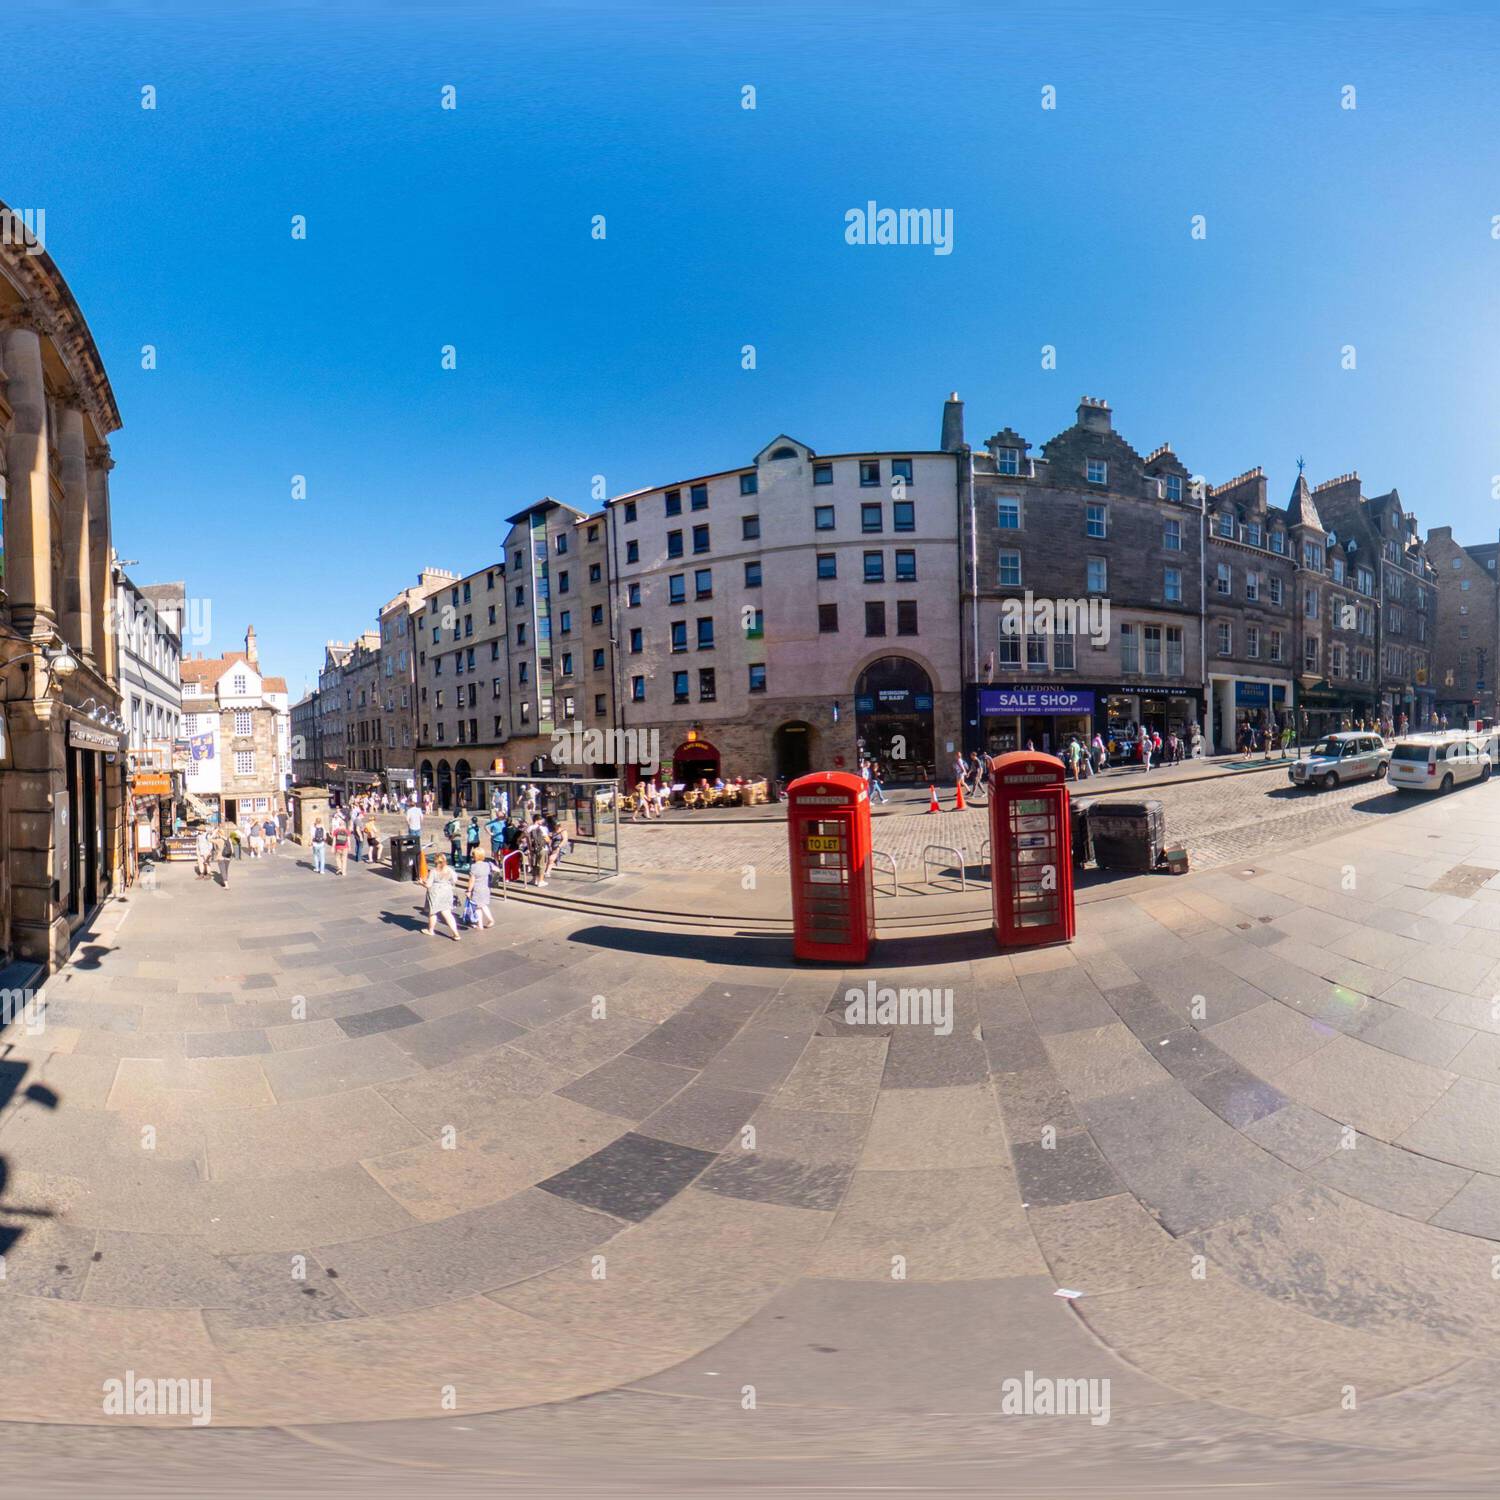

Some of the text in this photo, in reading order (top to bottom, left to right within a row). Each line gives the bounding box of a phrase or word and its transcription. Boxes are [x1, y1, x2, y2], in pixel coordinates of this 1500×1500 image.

[999, 694, 1078, 706] SALE SHOP
[809, 839, 838, 849] TO LET
